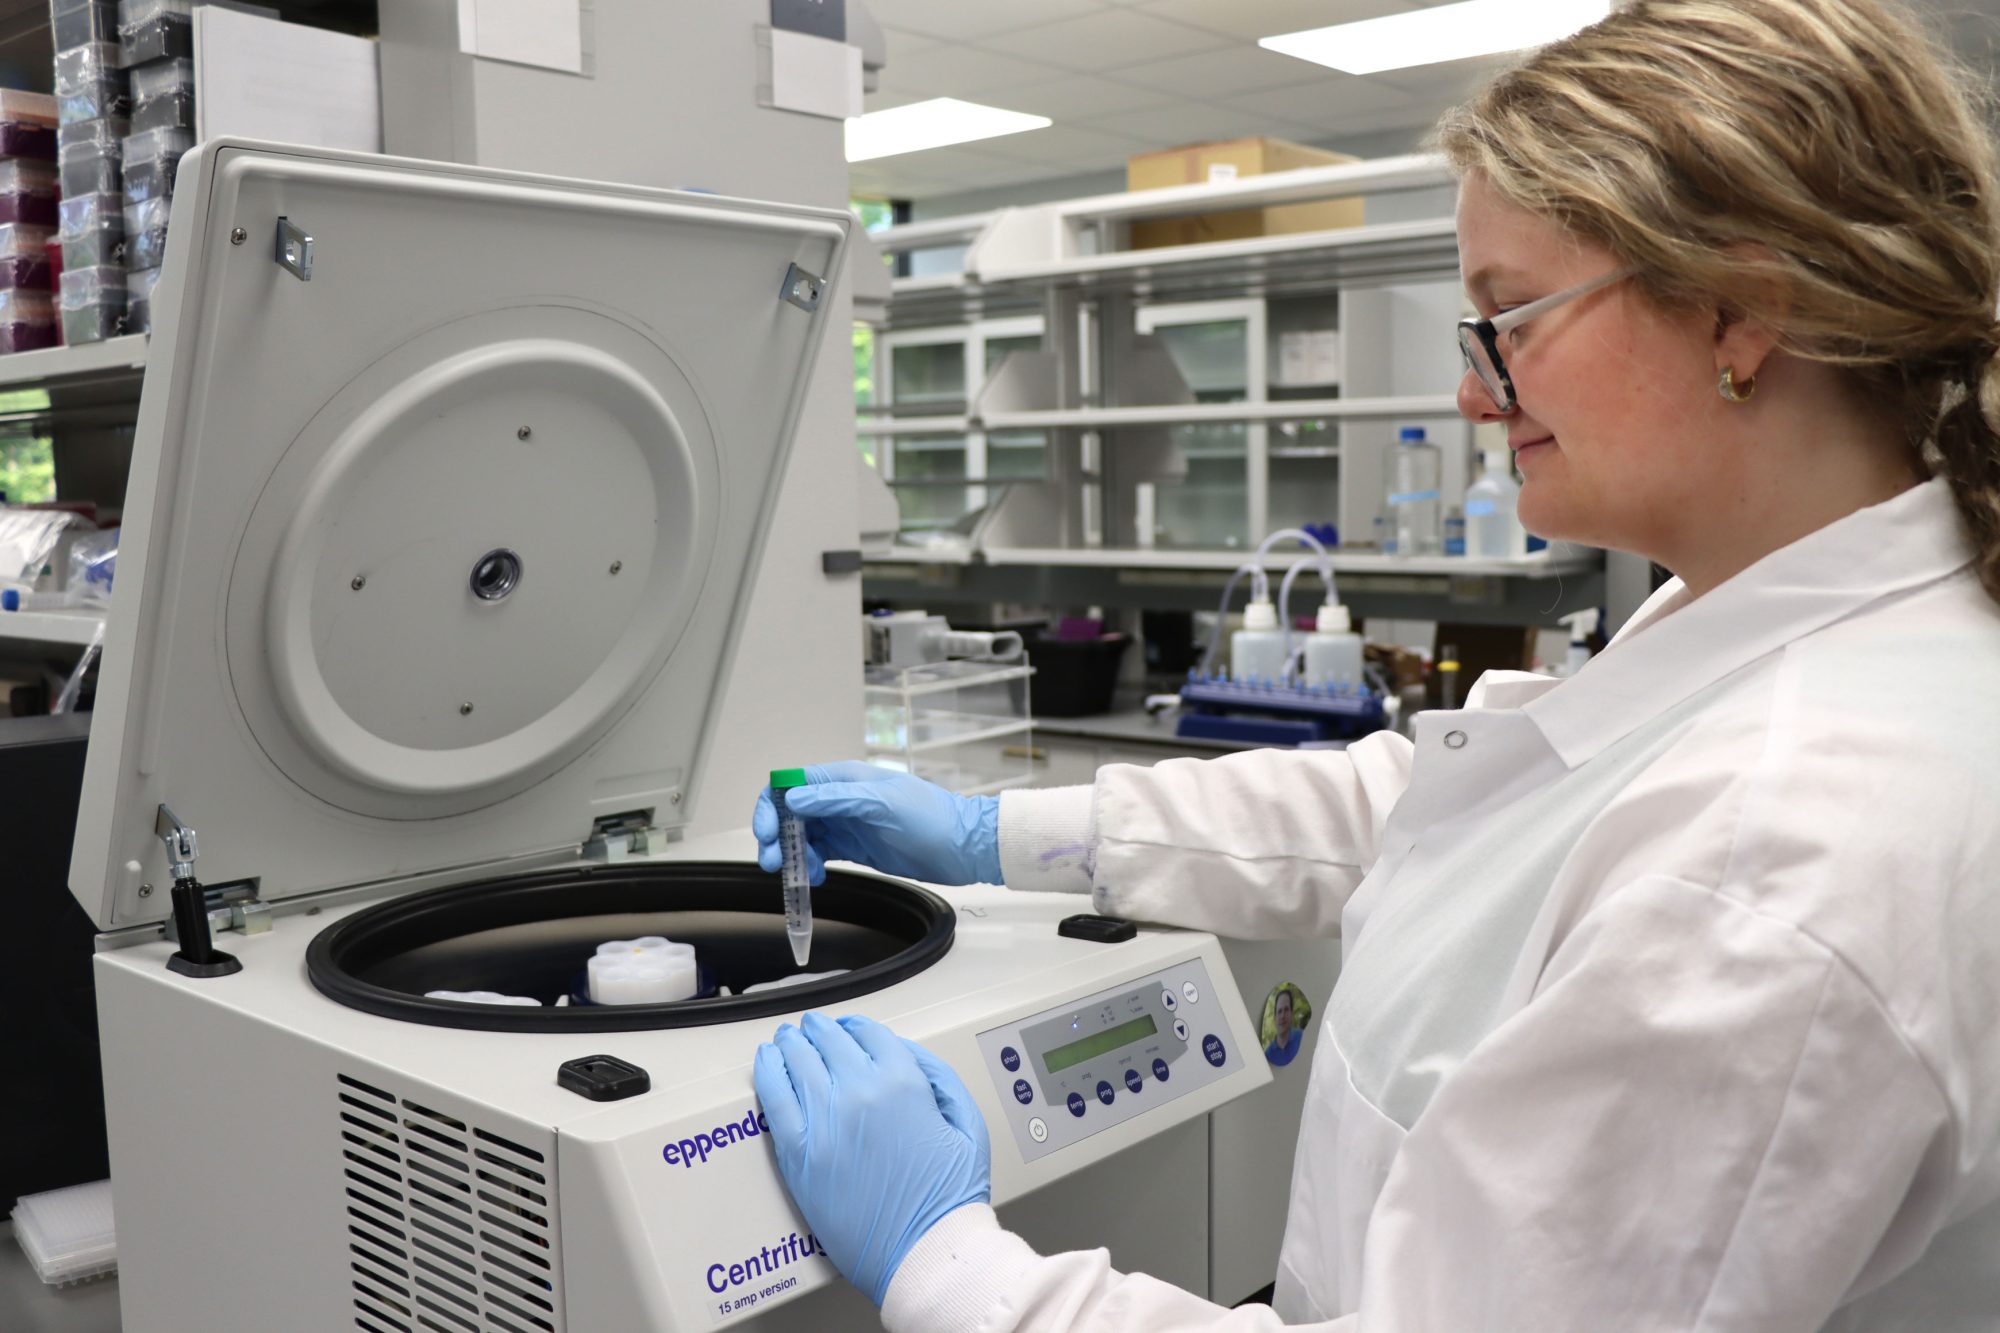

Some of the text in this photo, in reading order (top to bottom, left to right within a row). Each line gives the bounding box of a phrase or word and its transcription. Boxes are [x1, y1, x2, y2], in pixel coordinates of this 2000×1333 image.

[1206, 1040, 1220, 1052] start
[1003, 1054, 1018, 1065] short
[1210, 1050, 1223, 1061] stop
[1126, 1075, 1141, 1087] speed
[1017, 1091, 1032, 1101] temp
[1100, 1088, 1112, 1098] prog
[1070, 1100, 1084, 1110] temp
[706, 1232, 828, 1293] Centrifu
[718, 1276, 797, 1315] 15 amp version
